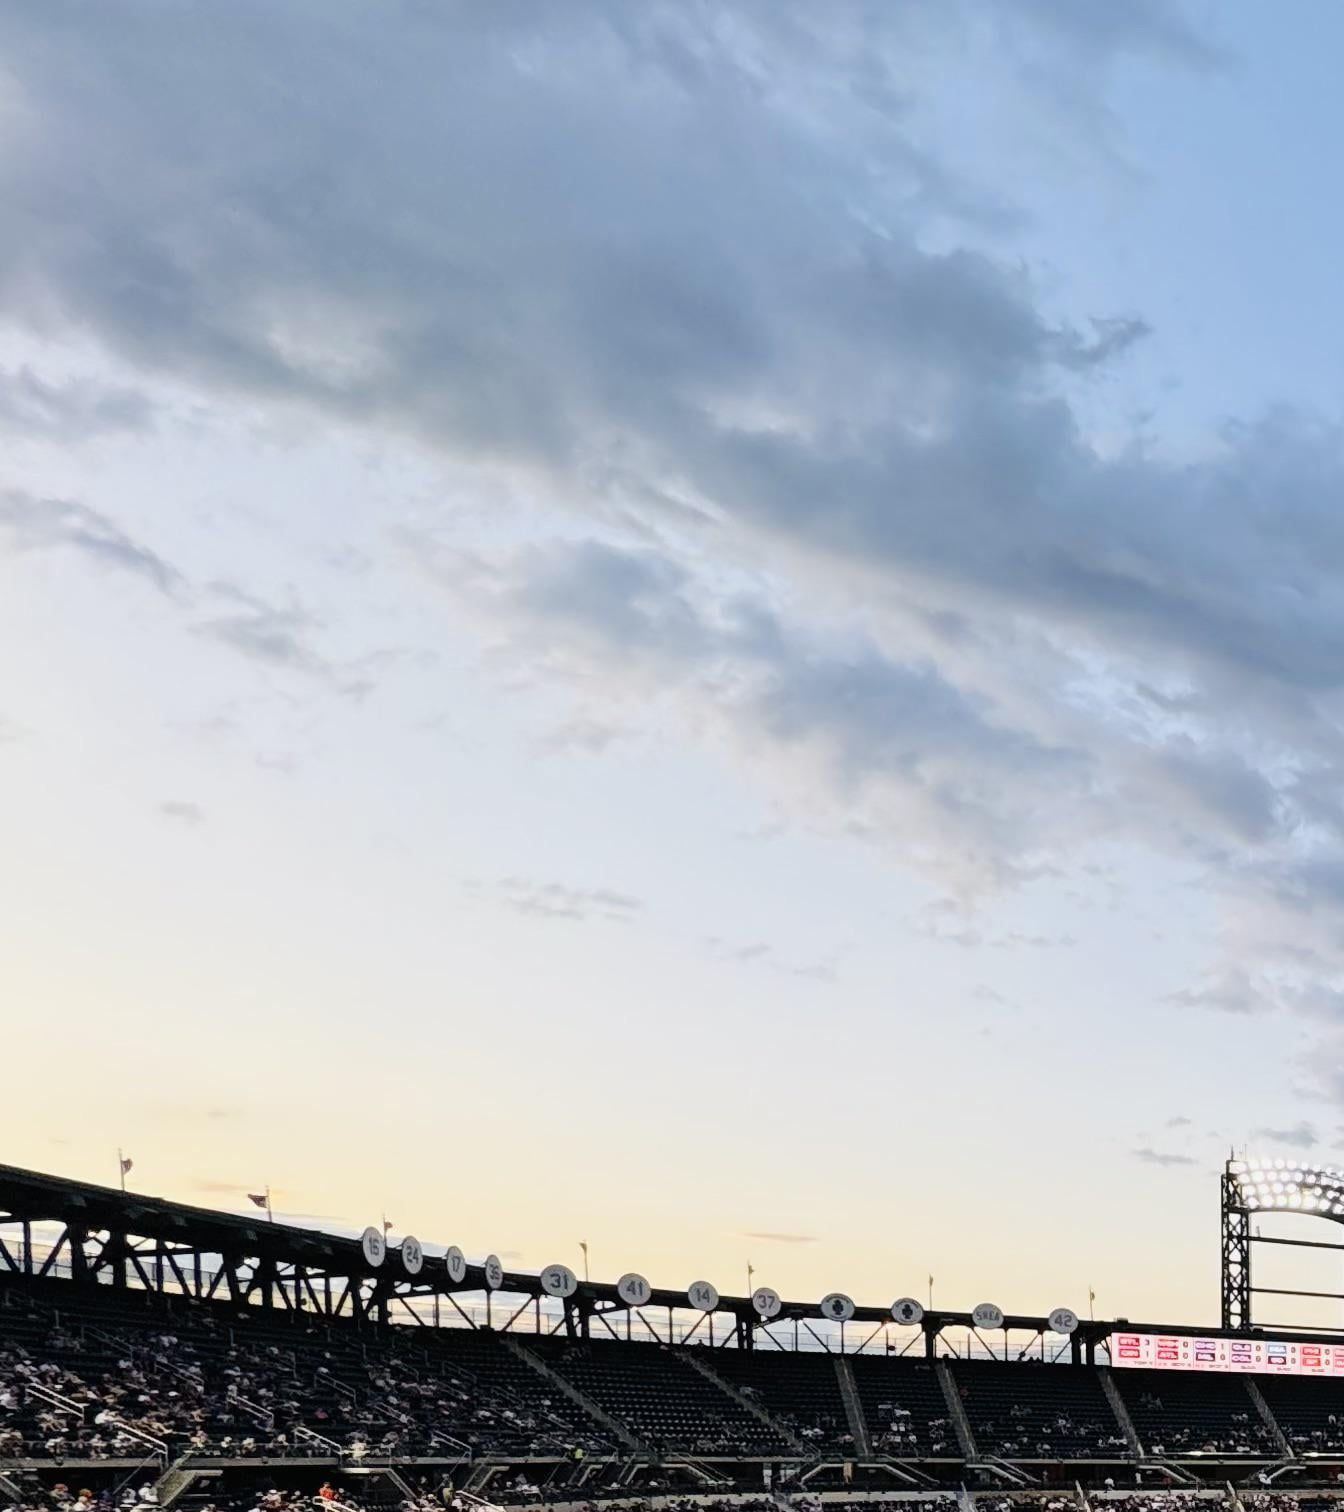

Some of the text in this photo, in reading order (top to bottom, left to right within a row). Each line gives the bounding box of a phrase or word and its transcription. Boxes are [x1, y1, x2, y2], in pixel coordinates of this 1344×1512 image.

[405, 1242, 419, 1264] 24
[452, 1254, 461, 1272] 17
[550, 1274, 568, 1290] 31
[626, 1281, 643, 1296] 41
[695, 1288, 710, 1303] 14
[757, 1295, 775, 1309] 37
[976, 1308, 999, 1321] SHEA
[1055, 1314, 1072, 1327] 42
